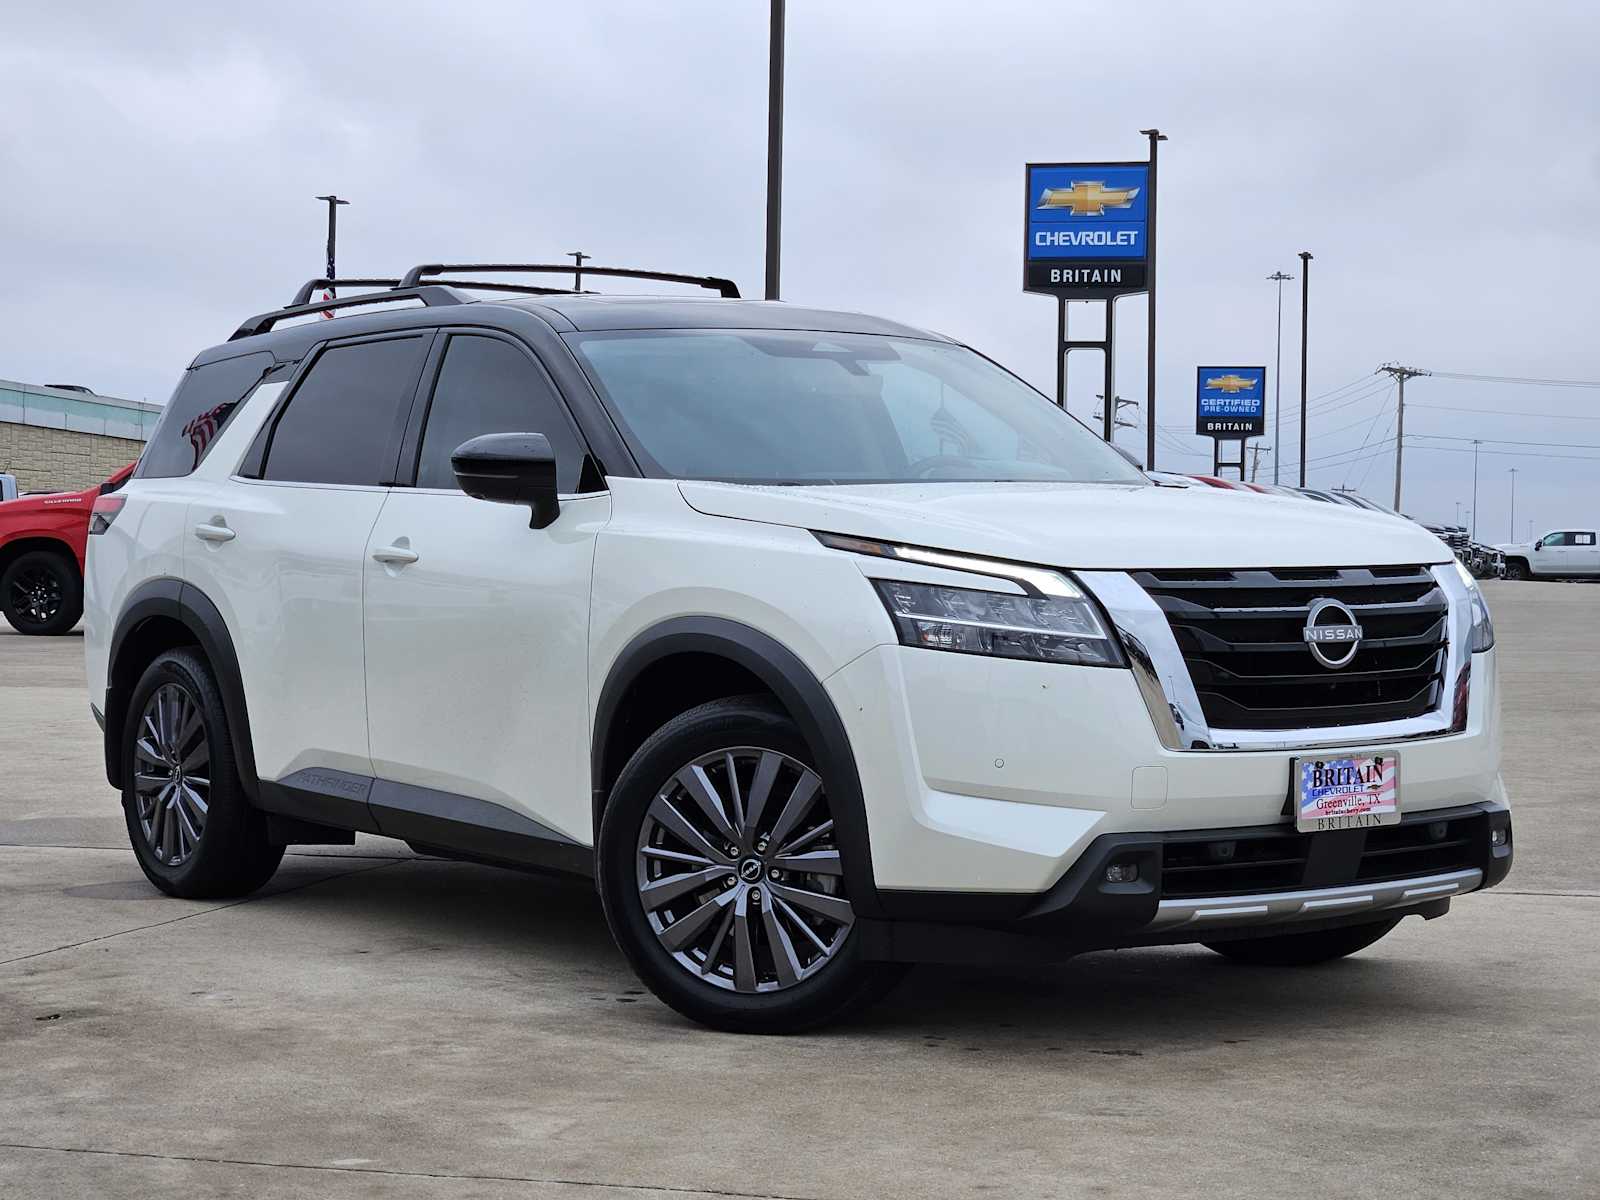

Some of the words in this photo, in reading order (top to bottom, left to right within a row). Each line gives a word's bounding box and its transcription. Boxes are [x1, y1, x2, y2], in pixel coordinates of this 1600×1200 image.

[1035, 231, 1138, 246] CHEVROLET
[1050, 268, 1121, 283] BRITAIN
[1204, 405, 1257, 413] PRE-OWNED
[1207, 422, 1253, 431] BRITAIN
[1305, 629, 1362, 640] NISSAN
[1313, 763, 1384, 788] BRITAIN
[1312, 785, 1364, 797] CHEVROLET
[1316, 795, 1366, 810] Greenville,
[1368, 794, 1381, 804] TX
[1317, 814, 1382, 830] BRITAIN
